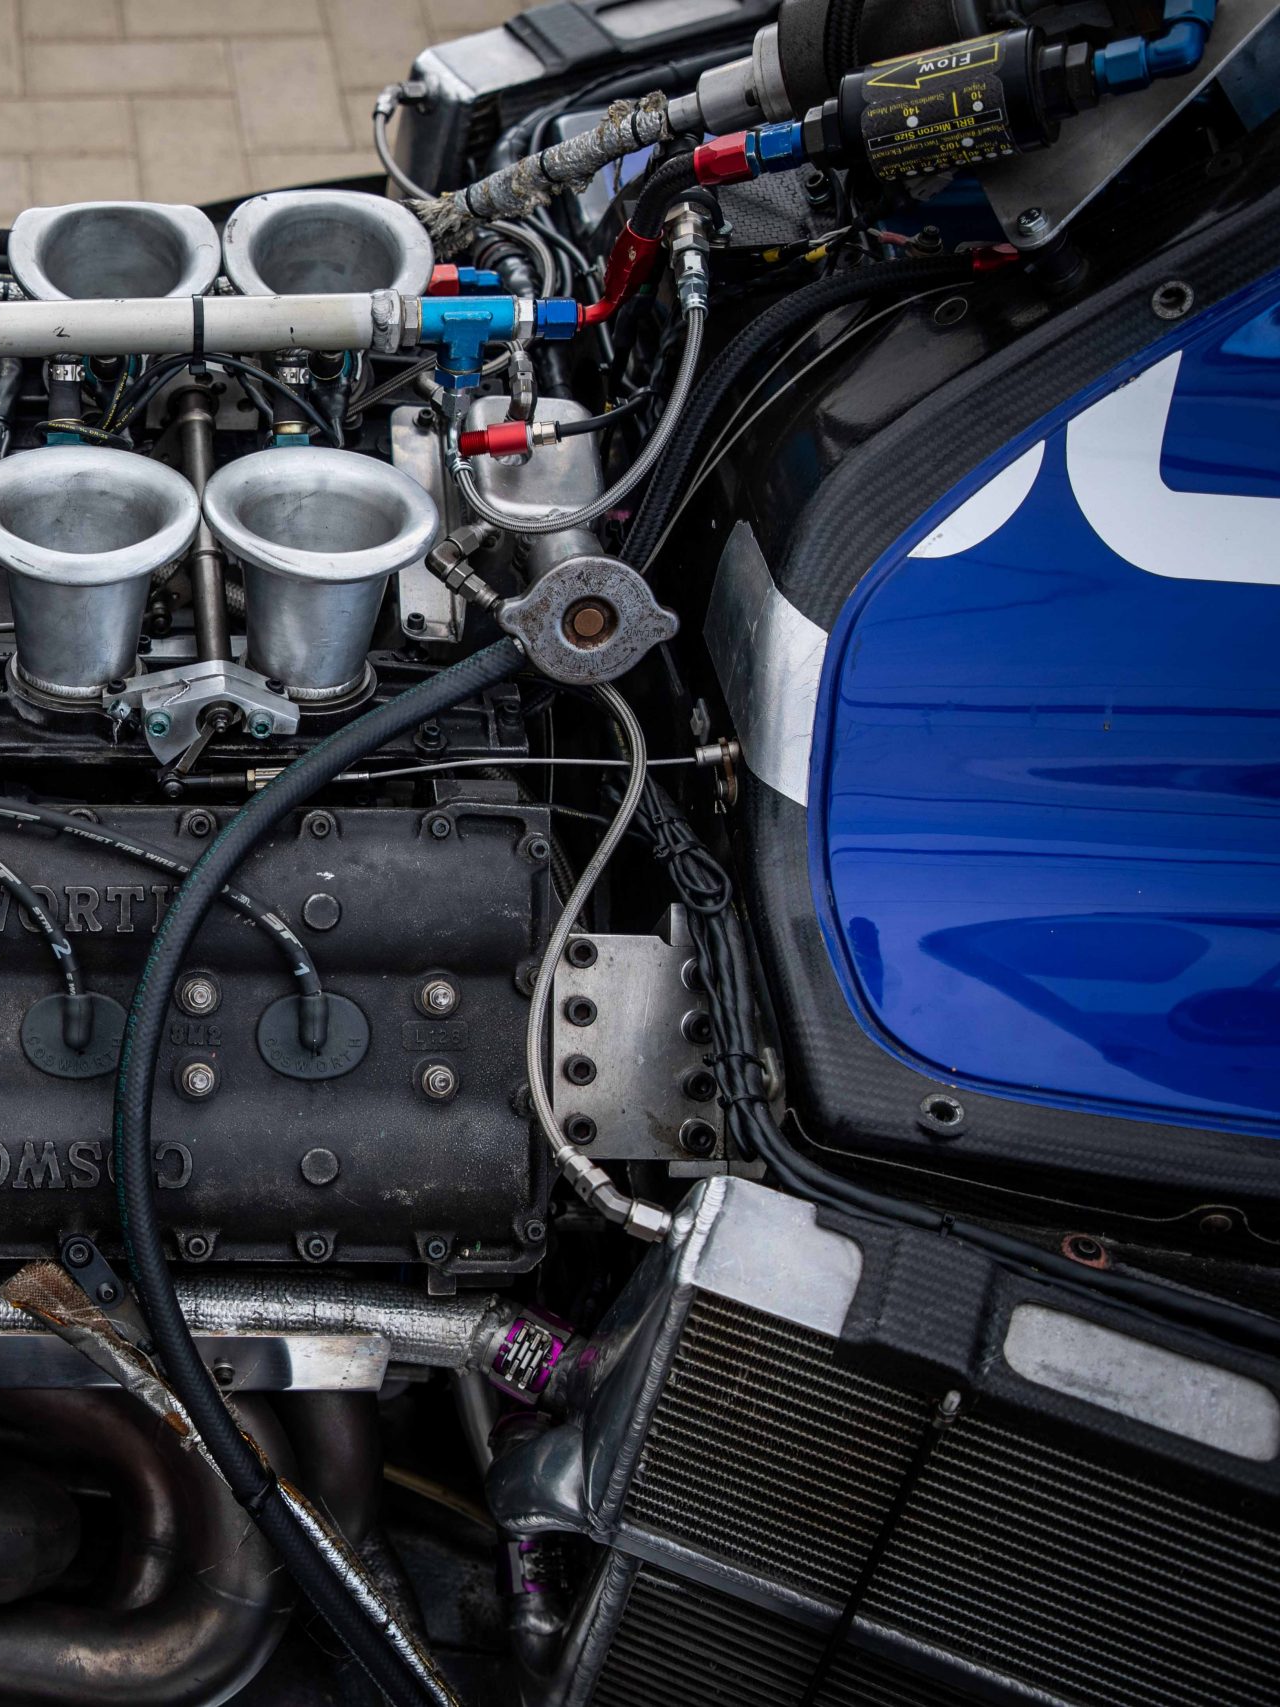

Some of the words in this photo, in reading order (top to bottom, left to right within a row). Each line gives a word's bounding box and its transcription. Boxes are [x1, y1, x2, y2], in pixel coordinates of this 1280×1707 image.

[919, 53, 970, 73] Flow
[971, 91, 982, 100] 10
[903, 107, 920, 117] 140
[917, 122, 951, 136] Micron
[953, 117, 975, 127] BRL
[894, 130, 916, 141] Size
[62, 826, 113, 845] STREET
[113, 841, 145, 856] FIRE
[144, 851, 177, 869] WIRE
[51, 938, 71, 960] 2
[293, 962, 311, 976] 1
[264, 1038, 362, 1073] COSWORTH
